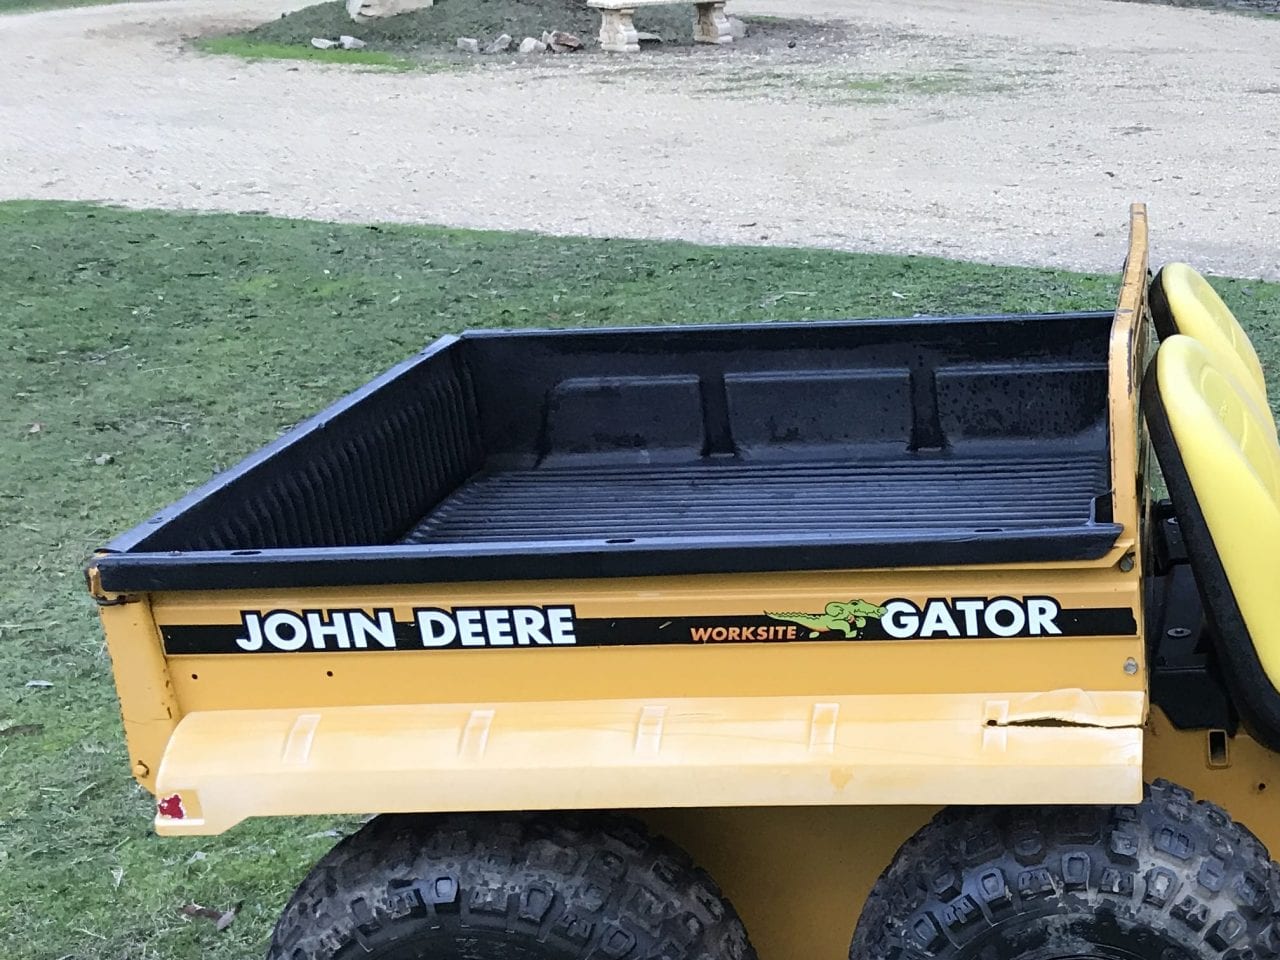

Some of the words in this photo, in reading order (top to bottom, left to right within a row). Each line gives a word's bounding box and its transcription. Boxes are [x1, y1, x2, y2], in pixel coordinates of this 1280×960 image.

[235, 610, 397, 652] JOHN
[415, 607, 577, 647] DEERE
[690, 625, 797, 642] WORKSITE
[880, 599, 1062, 639] GATOR
